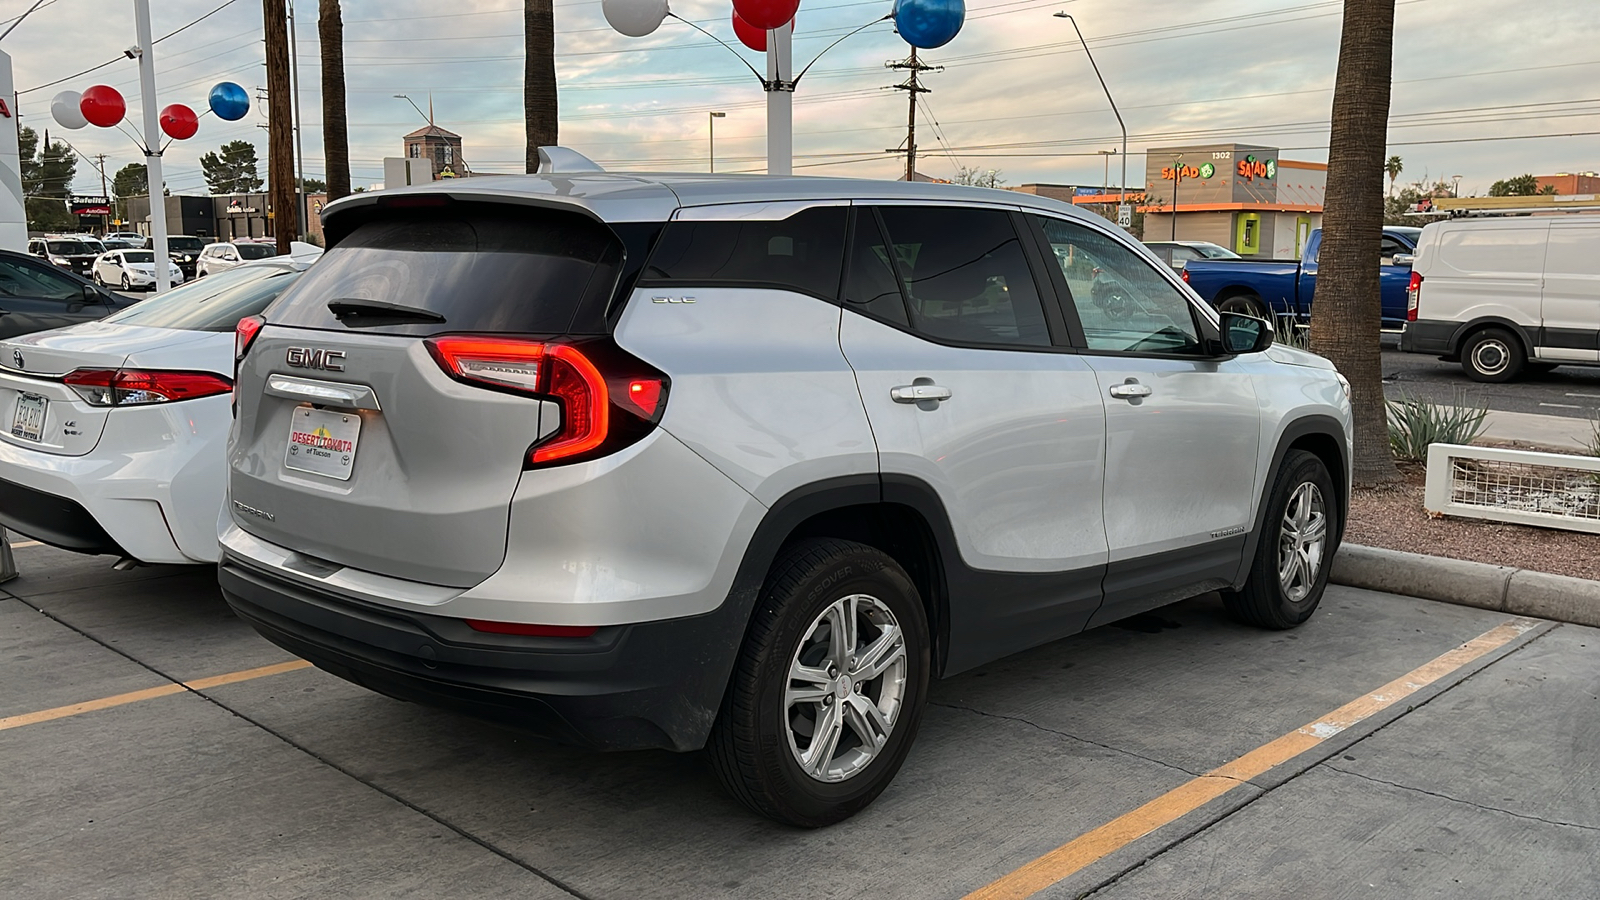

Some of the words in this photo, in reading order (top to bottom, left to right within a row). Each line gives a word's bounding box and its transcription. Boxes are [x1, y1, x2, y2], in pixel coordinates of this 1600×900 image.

[1211, 152, 1231, 160] 1302
[1161, 164, 1200, 182] SALAD
[1237, 160, 1267, 181] SALAD
[1119, 217, 1130, 226] 40
[651, 296, 697, 304] SLE
[286, 346, 348, 372] GMC
[292, 431, 321, 446] DESERT
[321, 436, 352, 453] TOYOTA
[312, 448, 331, 459] Tucson
[233, 499, 276, 522] TERRAIN
[788, 566, 853, 631] CROSSOVER
